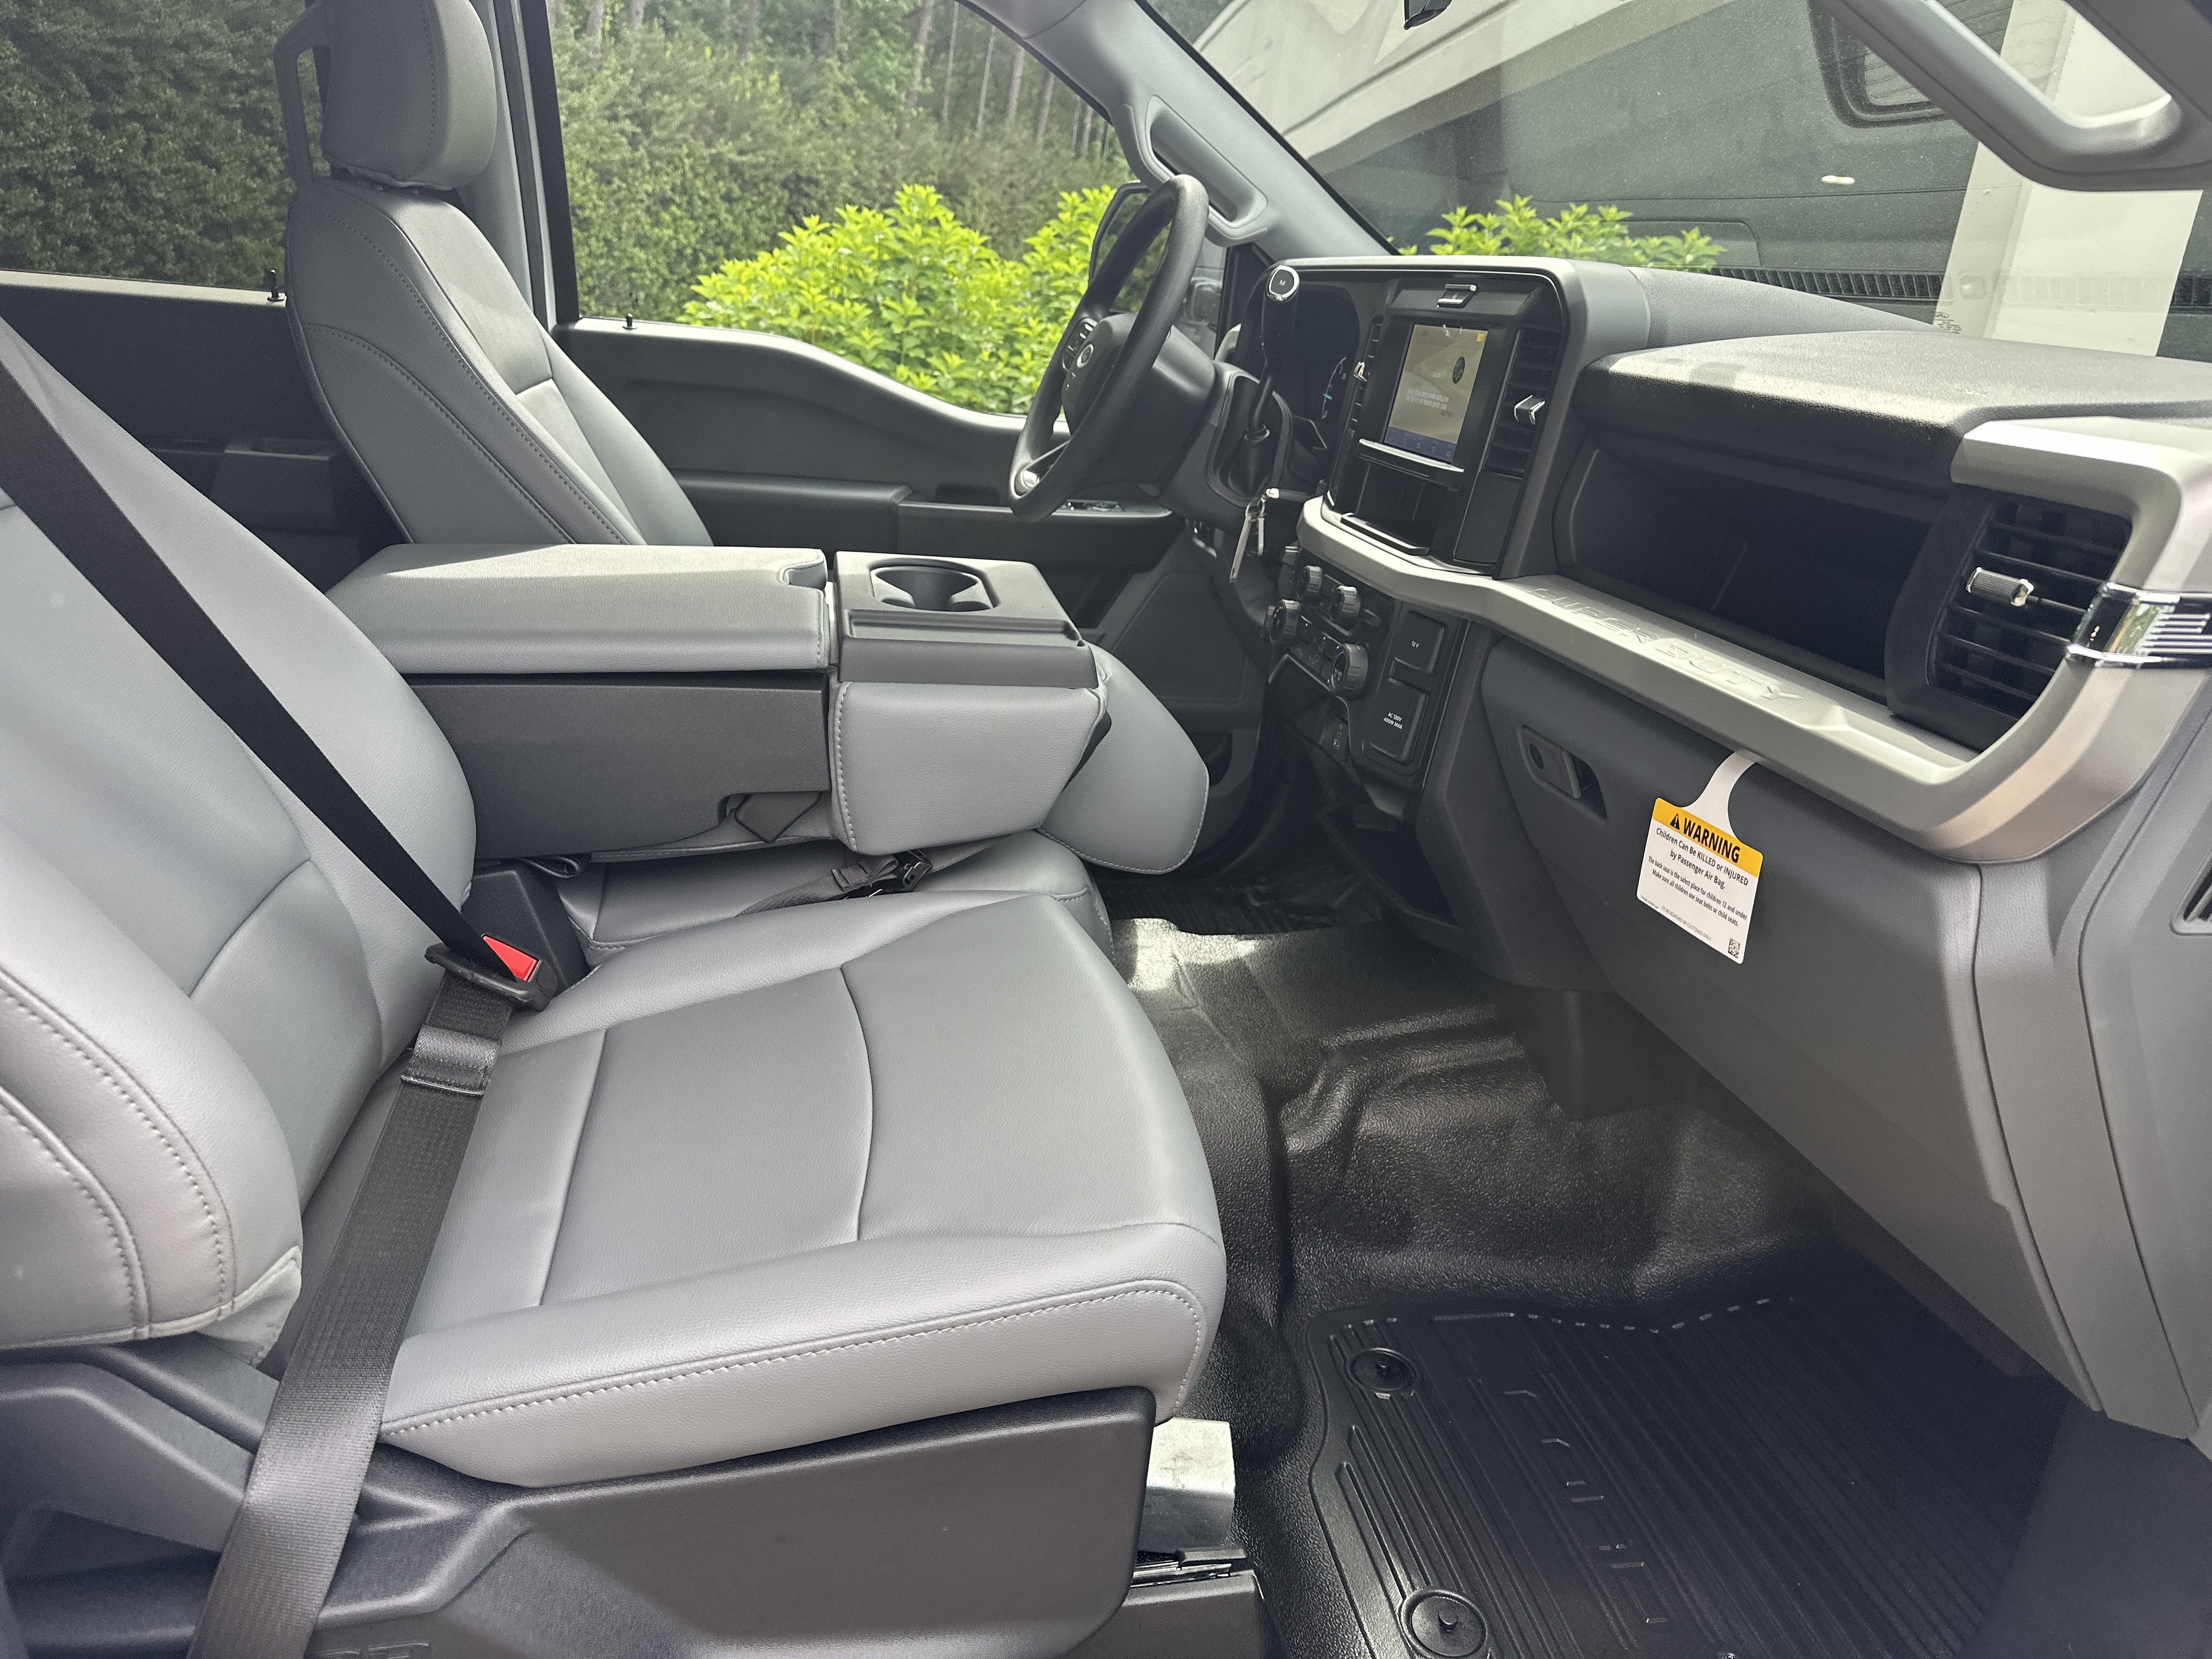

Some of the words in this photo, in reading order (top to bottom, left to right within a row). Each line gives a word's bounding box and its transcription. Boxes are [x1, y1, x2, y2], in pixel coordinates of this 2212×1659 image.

[1655, 644, 1803, 700] DUTY
[1393, 721, 1403, 730] MAX
[1656, 827, 1678, 845] Children
[1679, 840, 1689, 851] Can
[1689, 846, 1696, 856] Be
[1697, 850, 1716, 867] KILLED
[1716, 863, 1723, 871] or
[1723, 866, 1749, 886] INJURED
[1683, 817, 1741, 864] WARNING
[1652, 868, 1662, 879] Make
[1661, 876, 1669, 884] sure
[1674, 883, 1689, 896] children
[1695, 896, 1703, 905] seat
[1703, 900, 1713, 911] belts
[1718, 910, 1728, 920] child
[1654, 859, 1663, 869] back
[1662, 866, 1671, 874] seat
[1690, 882, 1700, 893] place
[1706, 891, 1722, 905] children
[1722, 900, 1727, 909] 12
[1726, 905, 1735, 913] and
[1670, 849, 1677, 861] by
[1677, 854, 1705, 876] Passenger
[1704, 870, 1713, 881] Air
[1713, 876, 1725, 890] Bag.
[1686, 922, 1703, 936] CUSTOMER
